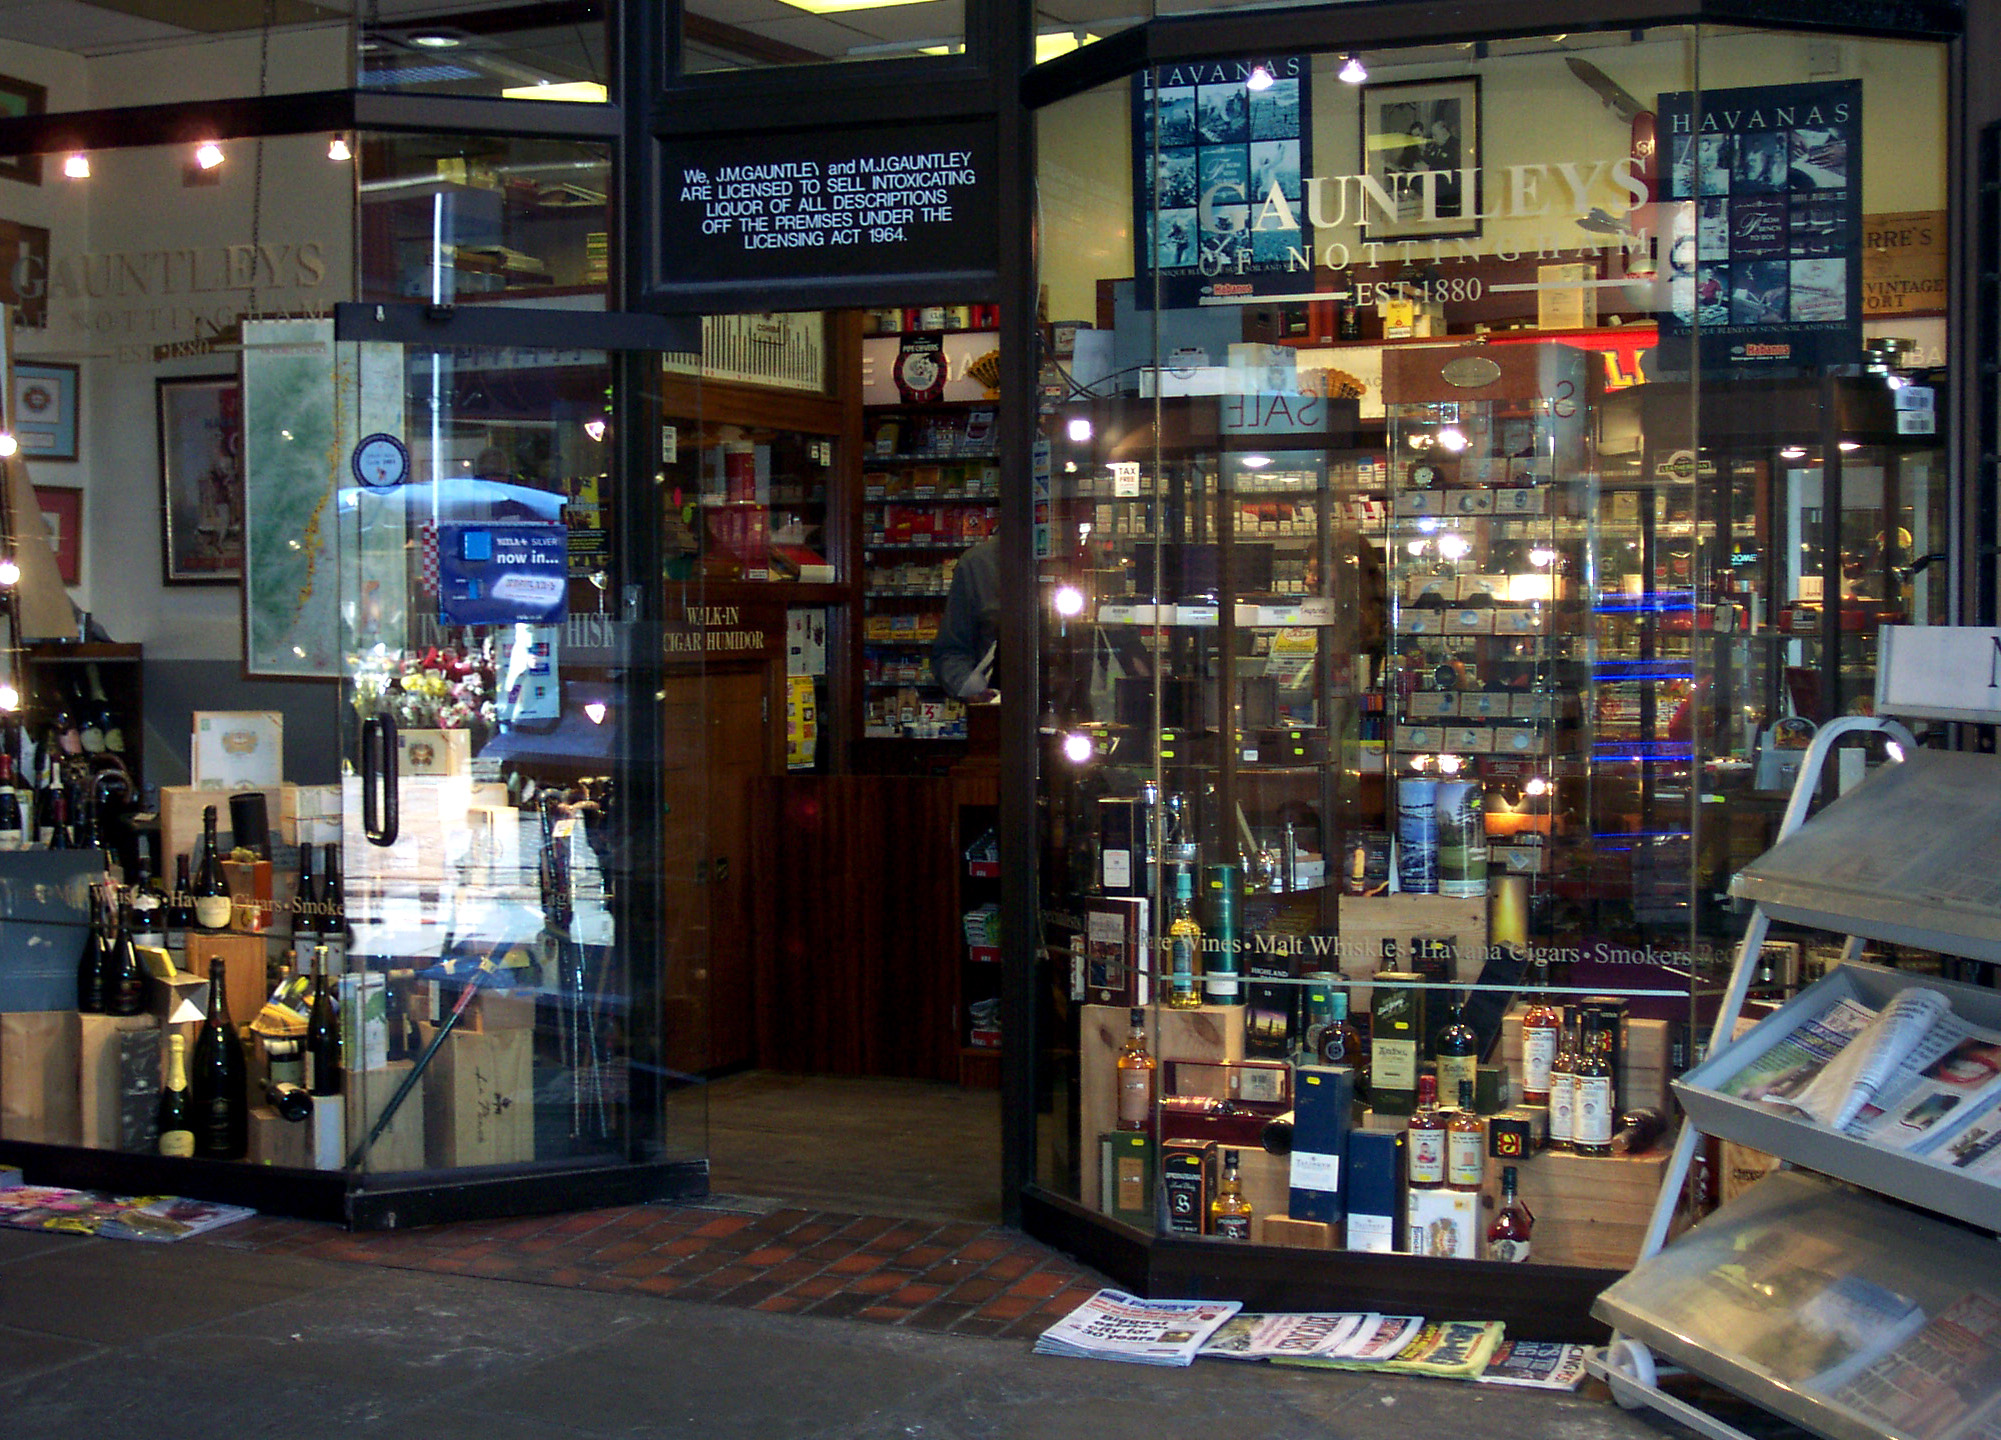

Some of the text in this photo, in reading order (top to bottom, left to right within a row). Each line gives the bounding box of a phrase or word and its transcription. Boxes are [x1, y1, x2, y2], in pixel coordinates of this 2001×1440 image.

[1143, 57, 1300, 88] HAVANAS
[1672, 103, 1850, 134] HAVANAS
[828, 159, 855, 176] and
[860, 152, 973, 173] M.J.GAUNTLEY
[680, 170, 976, 202] ARE LICENSED TO SELL INTOXICATING
[1200, 156, 1650, 235] GAUNTLEYS
[706, 189, 948, 218] LIQUOR OF ALL DESCRIPTIONS
[702, 207, 953, 235] OFF THE PREMISES UNDER THE
[744, 227, 908, 249] LICENSING ACT 1964.
[1286, 226, 1651, 273] NOTTINGHAM
[1421, 278, 1483, 304] 1880
[1866, 278, 1945, 295] VINTAGE
[1863, 294, 1906, 310] ORT
[1119, 467, 1136, 475] TAX
[531, 537, 558, 546] SILVER
[496, 552, 528, 565] now
[686, 606, 739, 626] WALK-IN
[663, 631, 765, 652] CIGAR HUMIDOR
[1255, 933, 1305, 955] Malt
[1420, 939, 1503, 961] Havana
[1508, 941, 1581, 969] Cigars
[1594, 943, 1693, 968] Smokers
